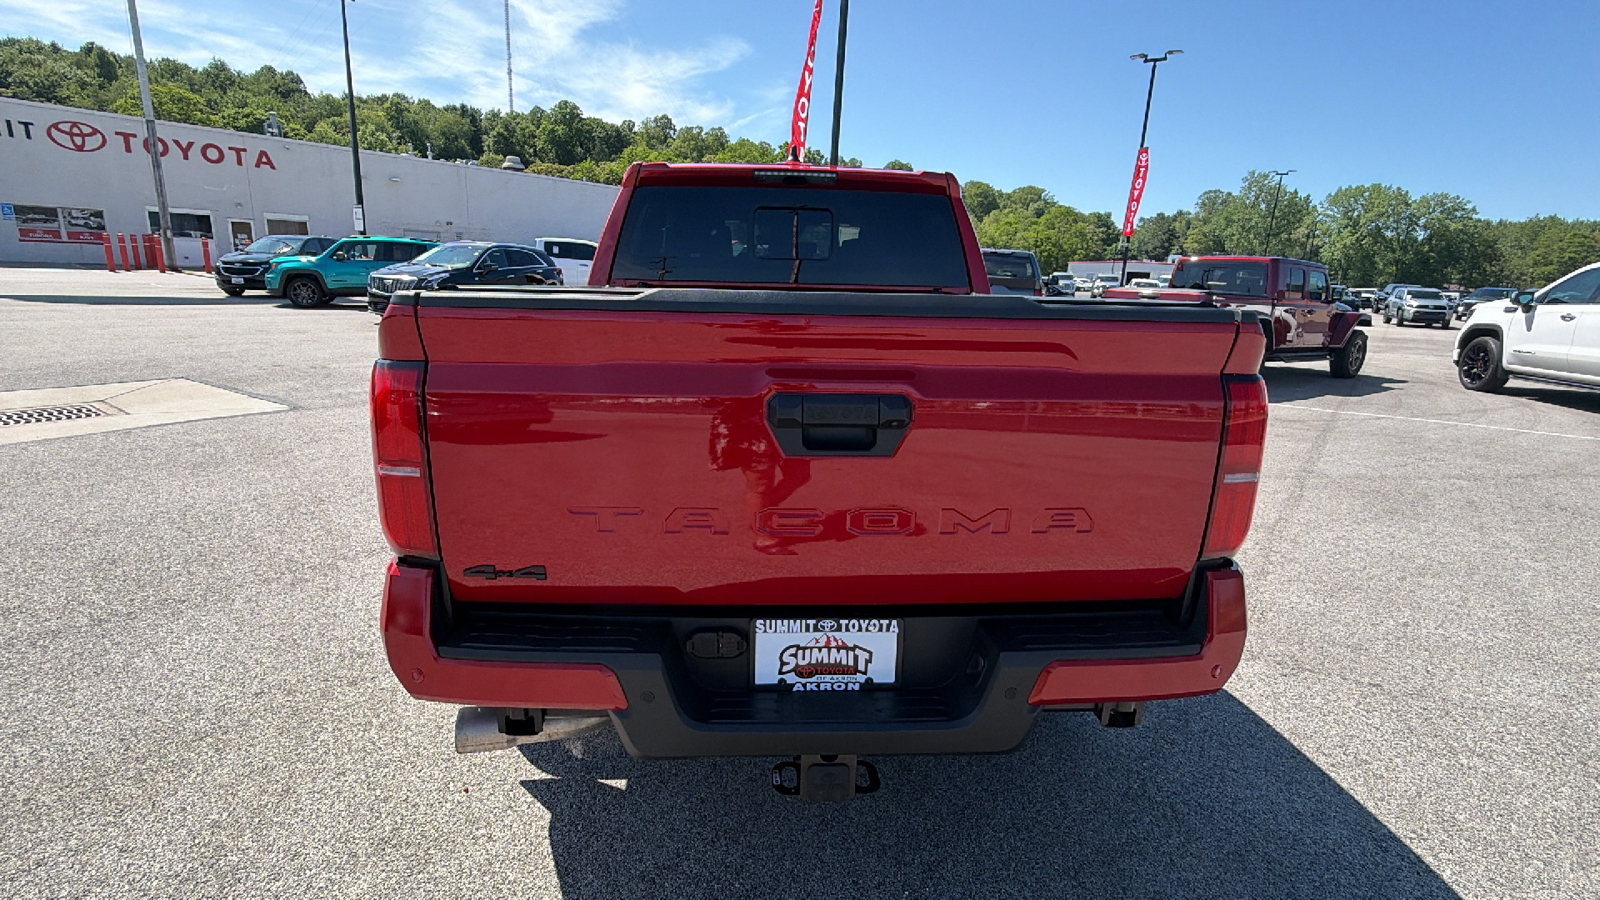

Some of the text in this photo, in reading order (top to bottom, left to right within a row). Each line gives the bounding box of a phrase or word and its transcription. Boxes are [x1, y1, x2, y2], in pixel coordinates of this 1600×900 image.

[0, 119, 277, 170] IT TOYOTA
[566, 506, 1096, 535] TACOMA
[755, 619, 899, 633] SUMMIT TOYOTA
[780, 645, 871, 673] SUMMIT
[817, 666, 855, 674] TOYOTA
[792, 682, 861, 692] AKRON
